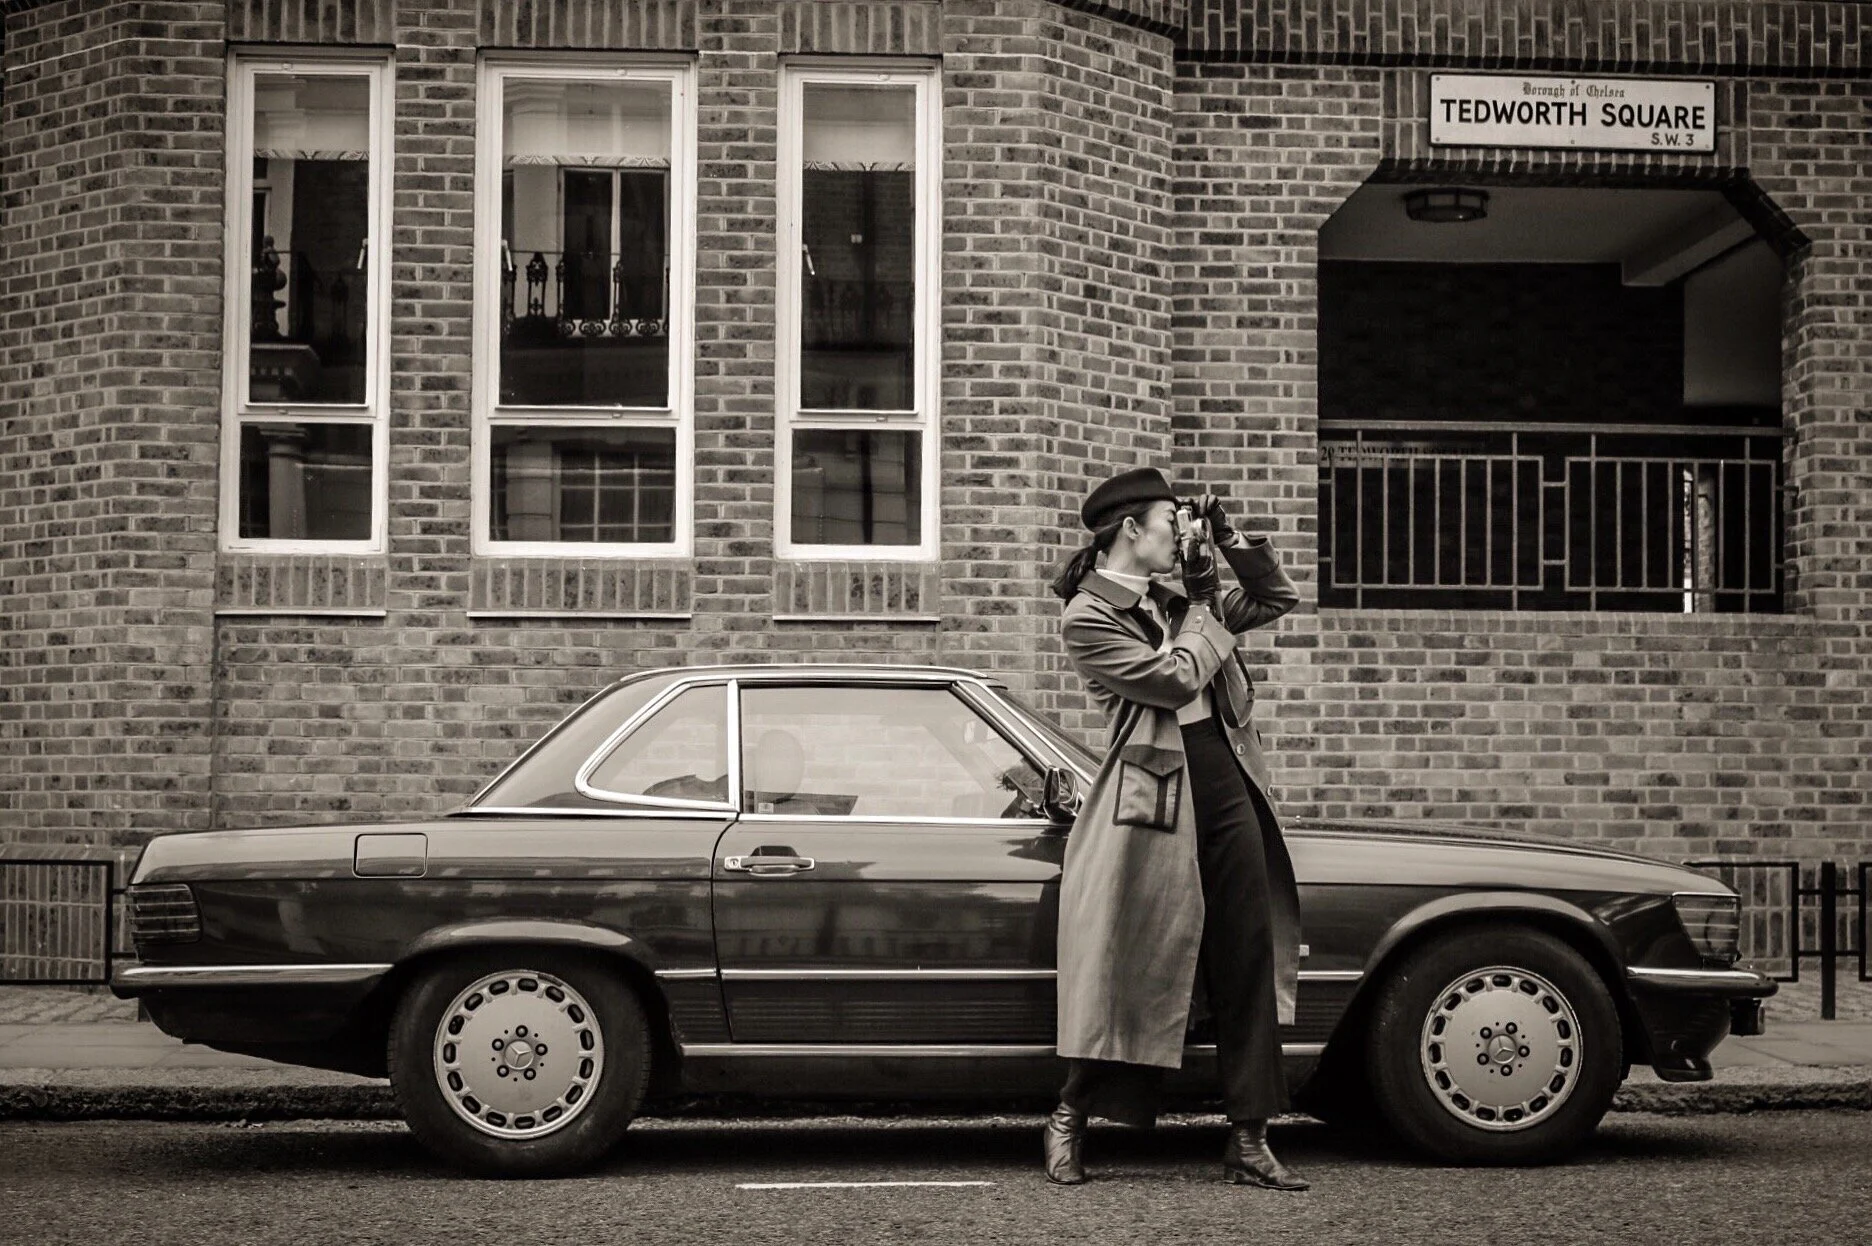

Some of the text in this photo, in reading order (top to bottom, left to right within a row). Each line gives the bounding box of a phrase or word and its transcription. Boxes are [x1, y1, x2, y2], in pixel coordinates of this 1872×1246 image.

[1523, 82, 1625, 98] Borough of Chelsea
[1440, 98, 1705, 129] TEDWORTH SQUARE
[1650, 132, 1695, 146] S.W. 3
